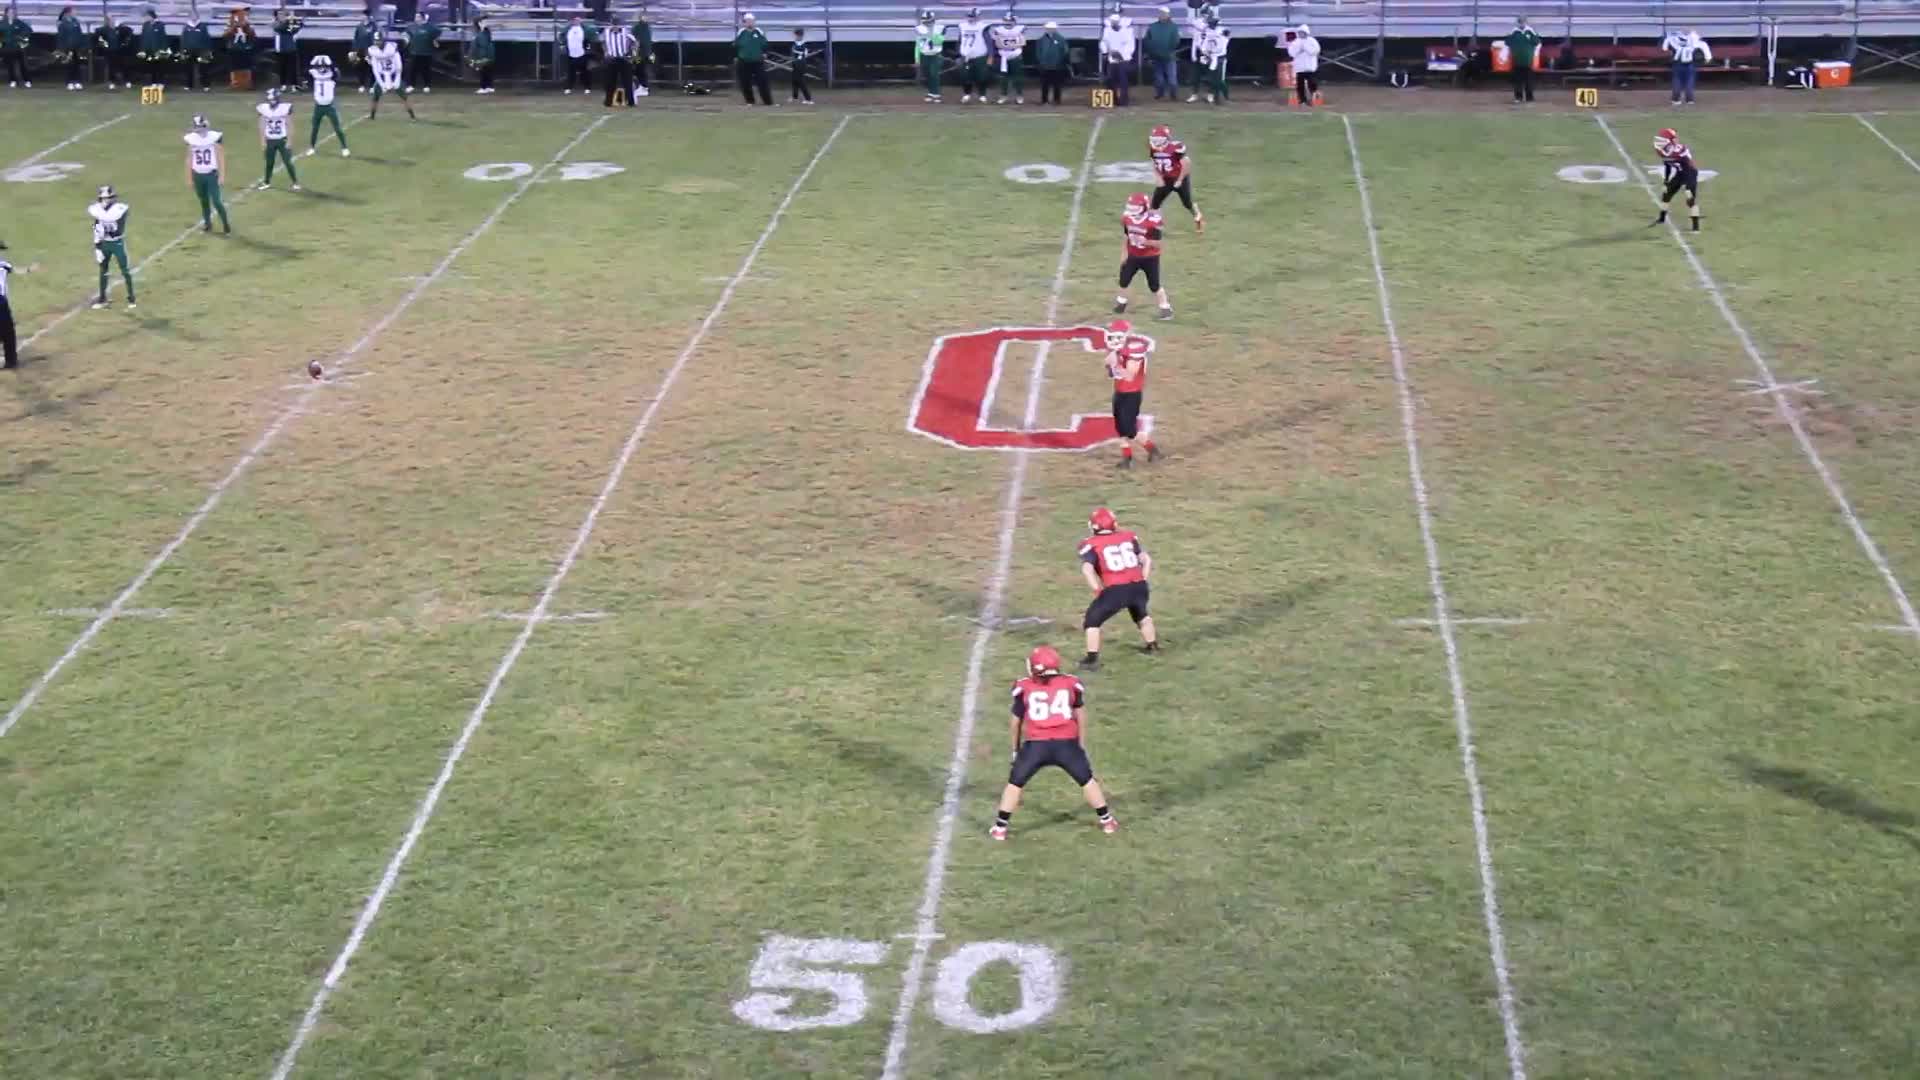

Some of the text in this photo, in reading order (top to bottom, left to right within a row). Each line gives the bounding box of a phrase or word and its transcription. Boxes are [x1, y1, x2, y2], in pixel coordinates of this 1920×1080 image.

[143, 87, 161, 104] 30
[1093, 90, 1111, 107] 50
[1577, 89, 1596, 106] 40
[906, 325, 1155, 453] C
[1103, 541, 1138, 572] 66
[1027, 689, 1073, 721] 64
[731, 935, 1068, 1033] 50
